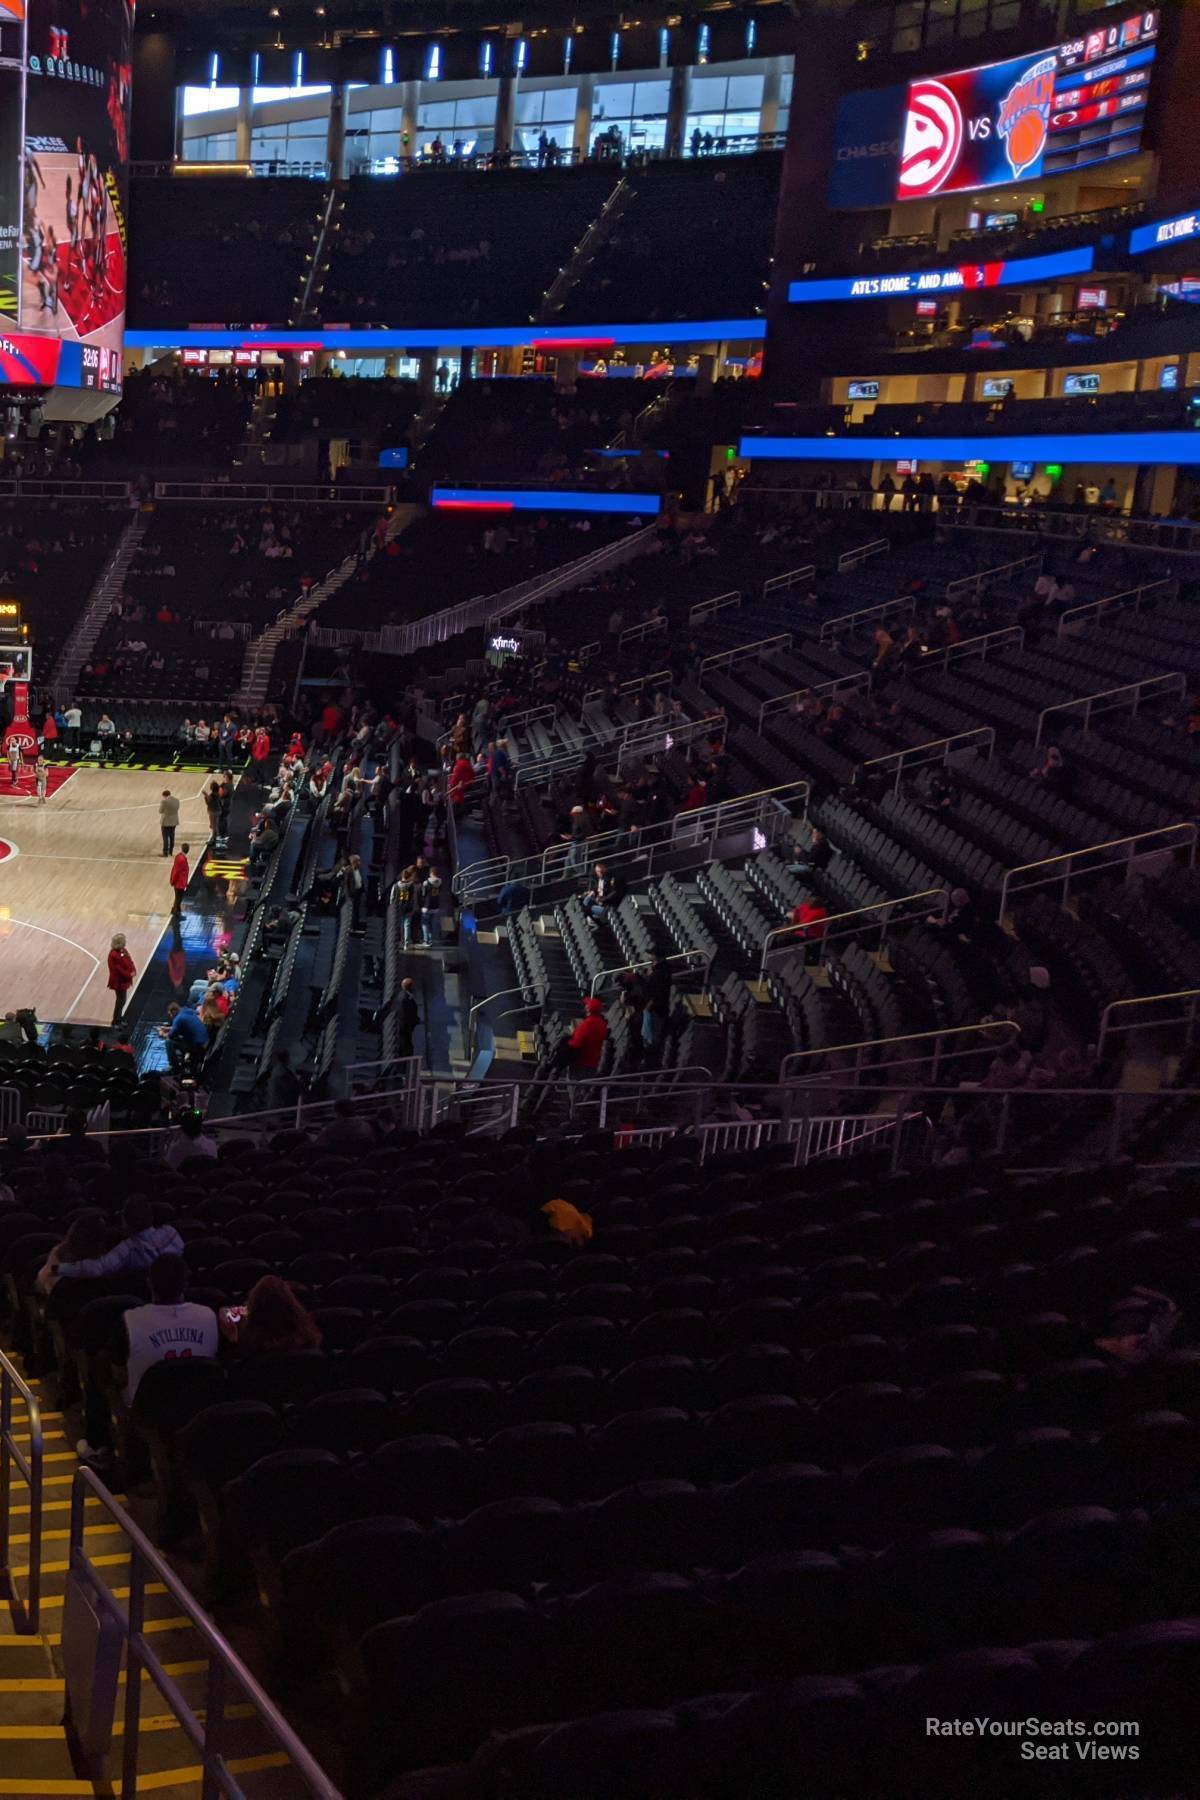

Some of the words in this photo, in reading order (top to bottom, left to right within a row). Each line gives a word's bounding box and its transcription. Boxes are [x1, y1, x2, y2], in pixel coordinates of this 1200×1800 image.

[968, 117, 991, 141] VS
[836, 142, 889, 161] CHASE
[851, 279, 879, 295] ATL'S
[879, 276, 911, 292] HOME
[917, 274, 941, 289] AND
[492, 636, 518, 652] xfinity
